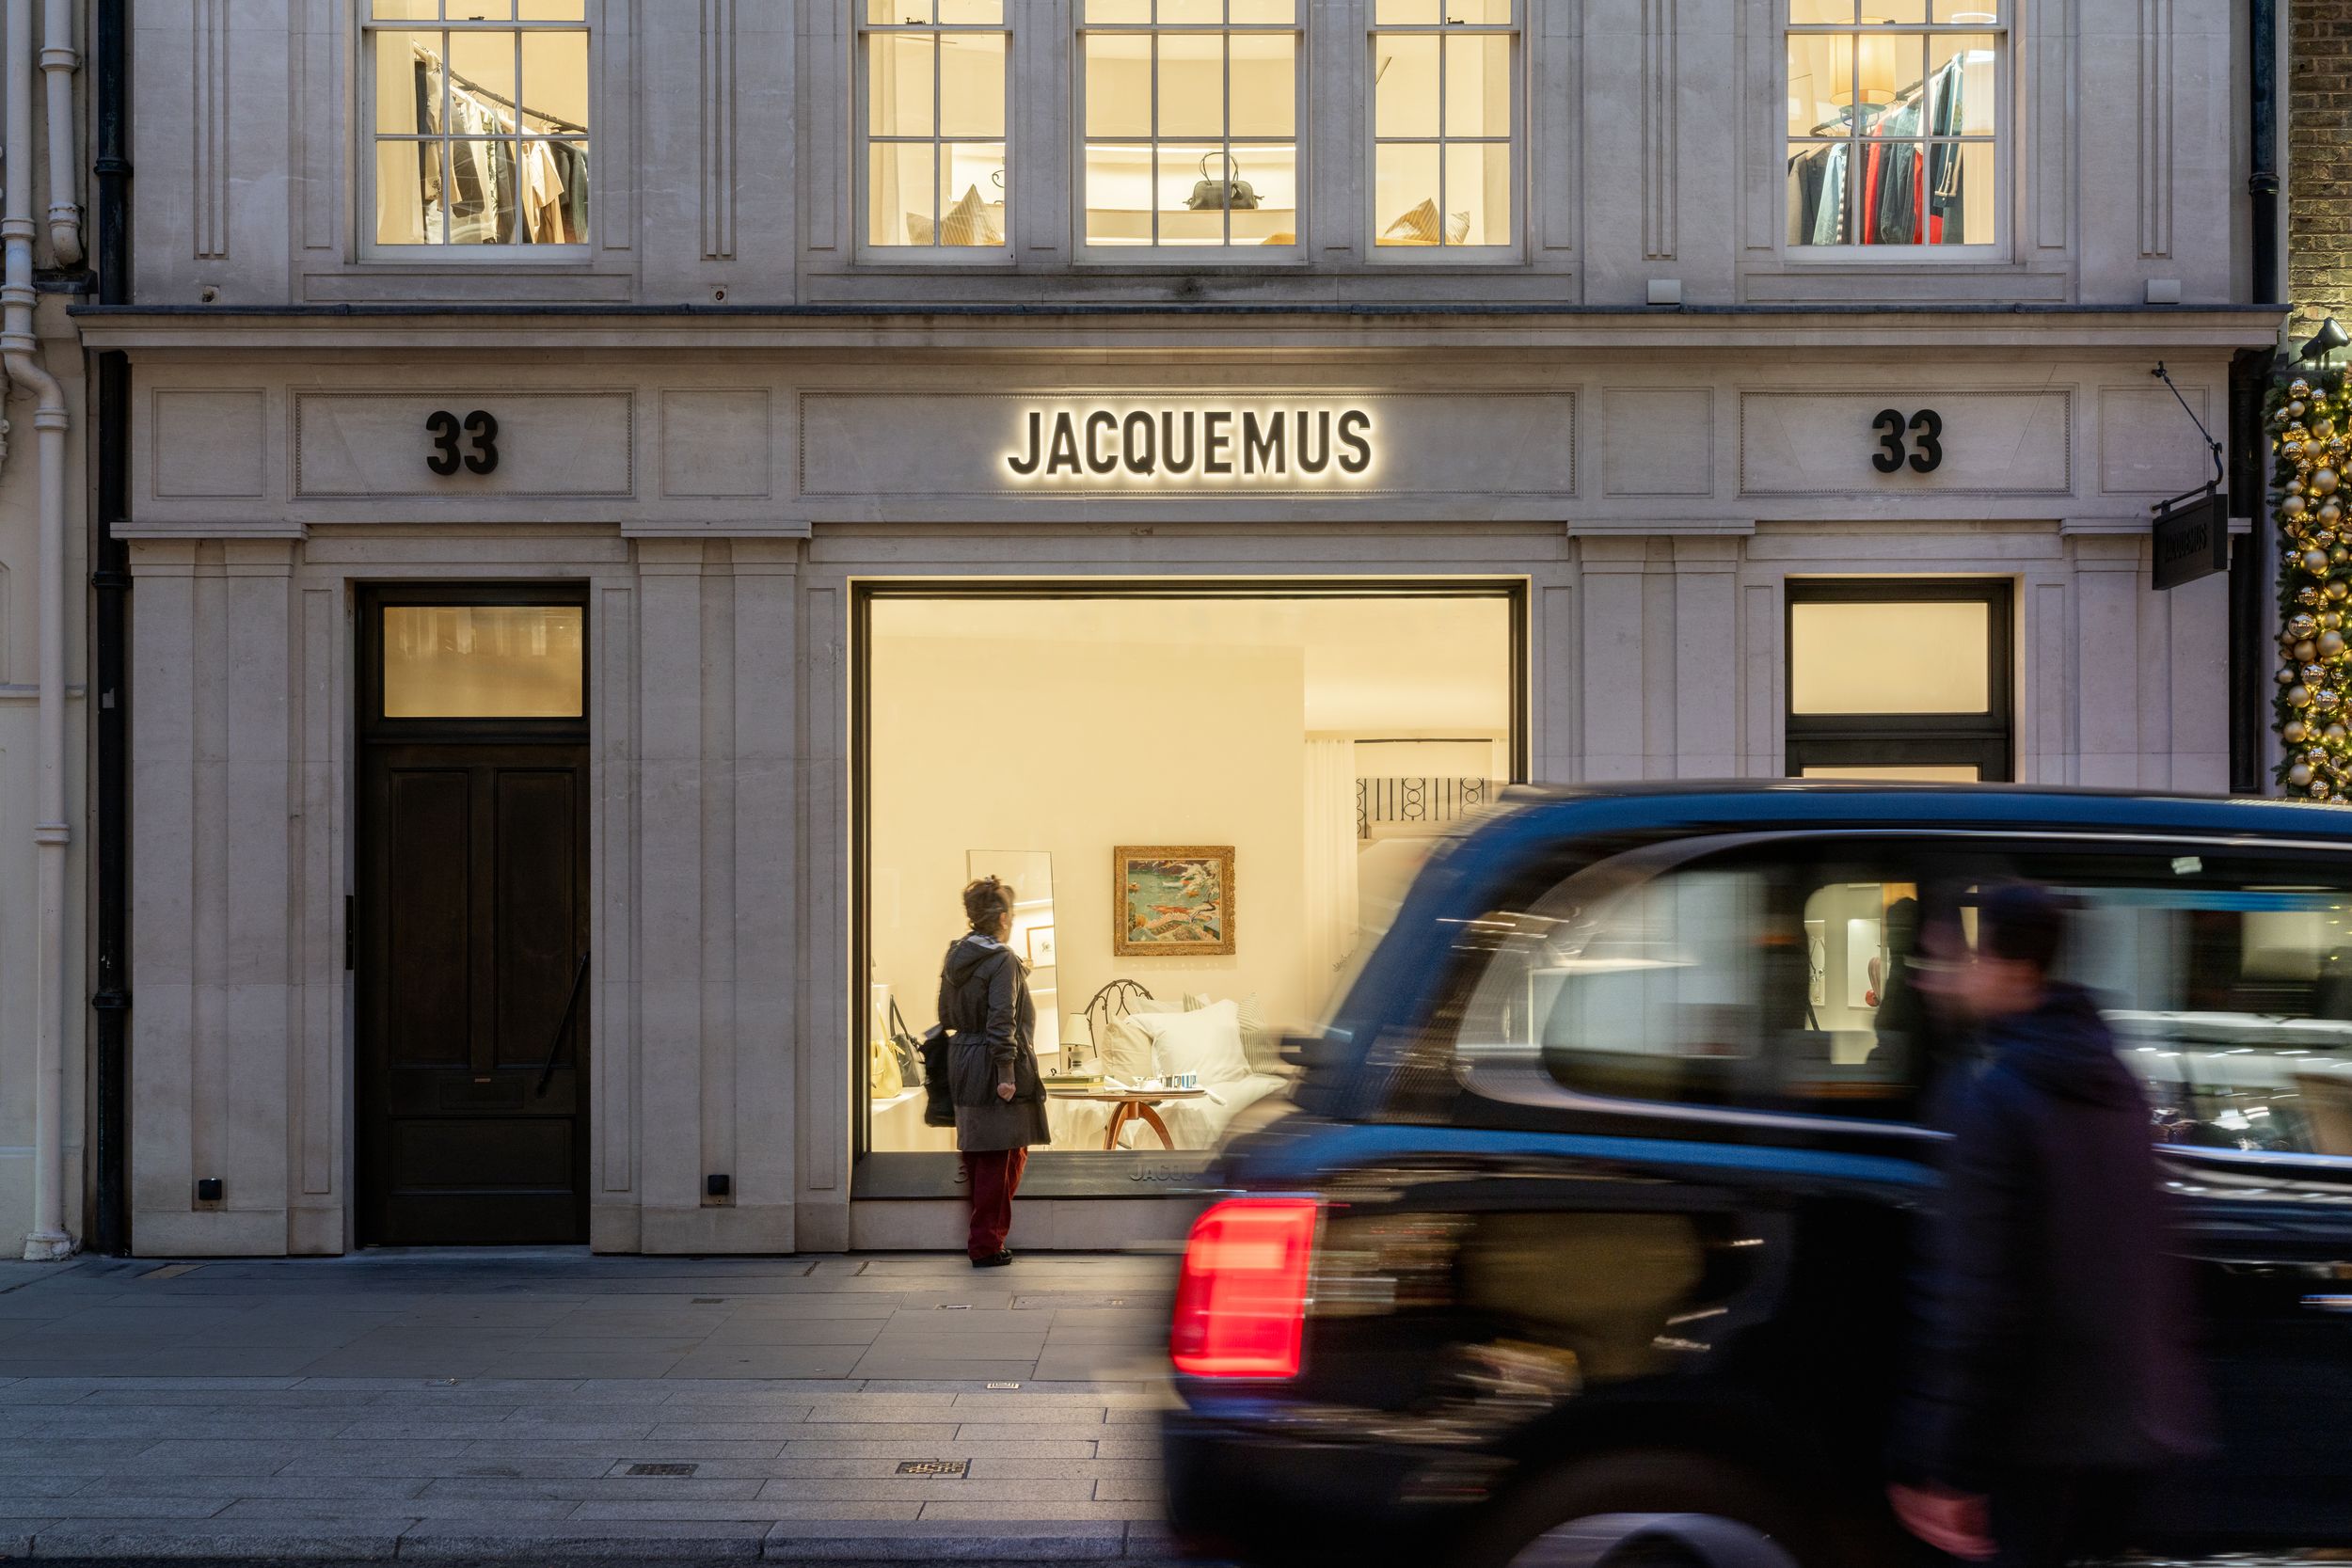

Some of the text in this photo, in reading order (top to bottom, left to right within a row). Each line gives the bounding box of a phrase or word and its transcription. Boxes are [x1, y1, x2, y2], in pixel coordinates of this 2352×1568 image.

[426, 410, 499, 476] 33
[1008, 409, 1372, 477] JACQUEMUS
[1871, 408, 1943, 474] 33
[1129, 1164, 1198, 1182] JACQU
